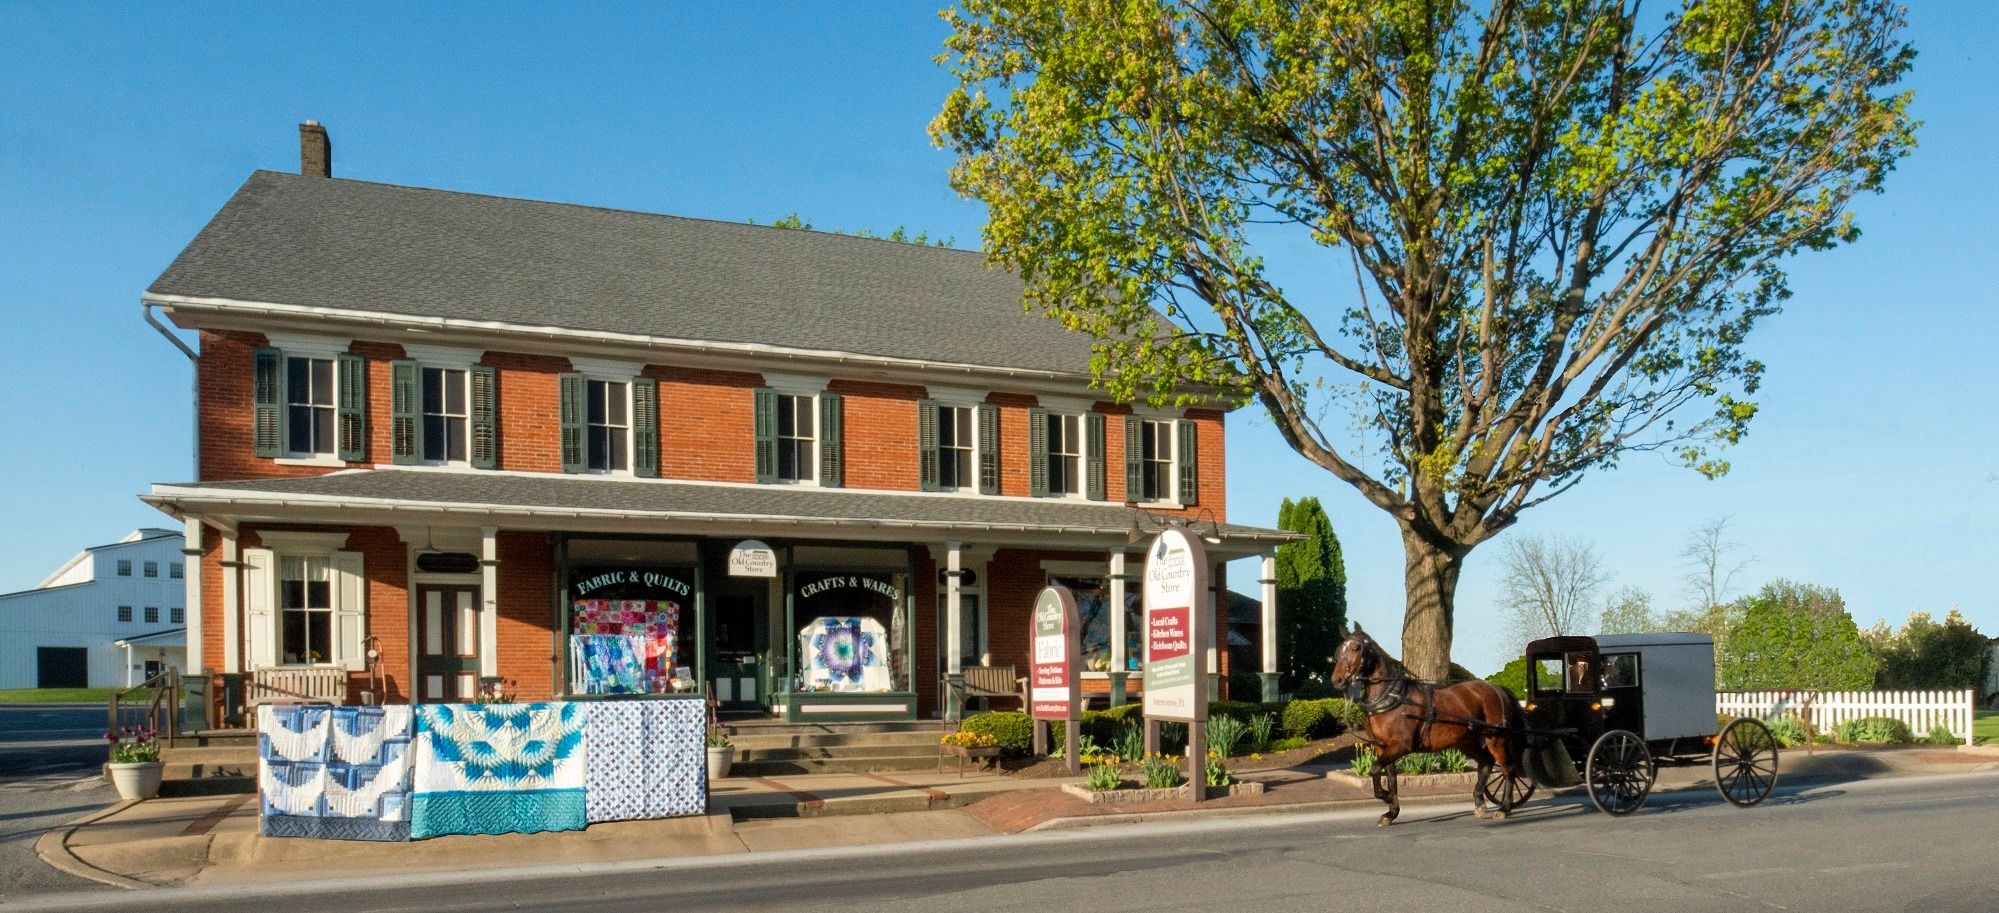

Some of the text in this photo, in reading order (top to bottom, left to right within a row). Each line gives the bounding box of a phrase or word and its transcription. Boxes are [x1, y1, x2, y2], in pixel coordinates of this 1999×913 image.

[745, 559, 774, 569] Country
[1149, 567, 1190, 582] Old Country
[576, 570, 691, 596] FABRIC & QUILTS
[801, 576, 900, 600] CRAFTS & WARES
[1160, 582, 1181, 594] Store
[1165, 616, 1178, 625] Crafts
[1038, 639, 1062, 660] Fabric
[1172, 640, 1187, 651] Quilts
